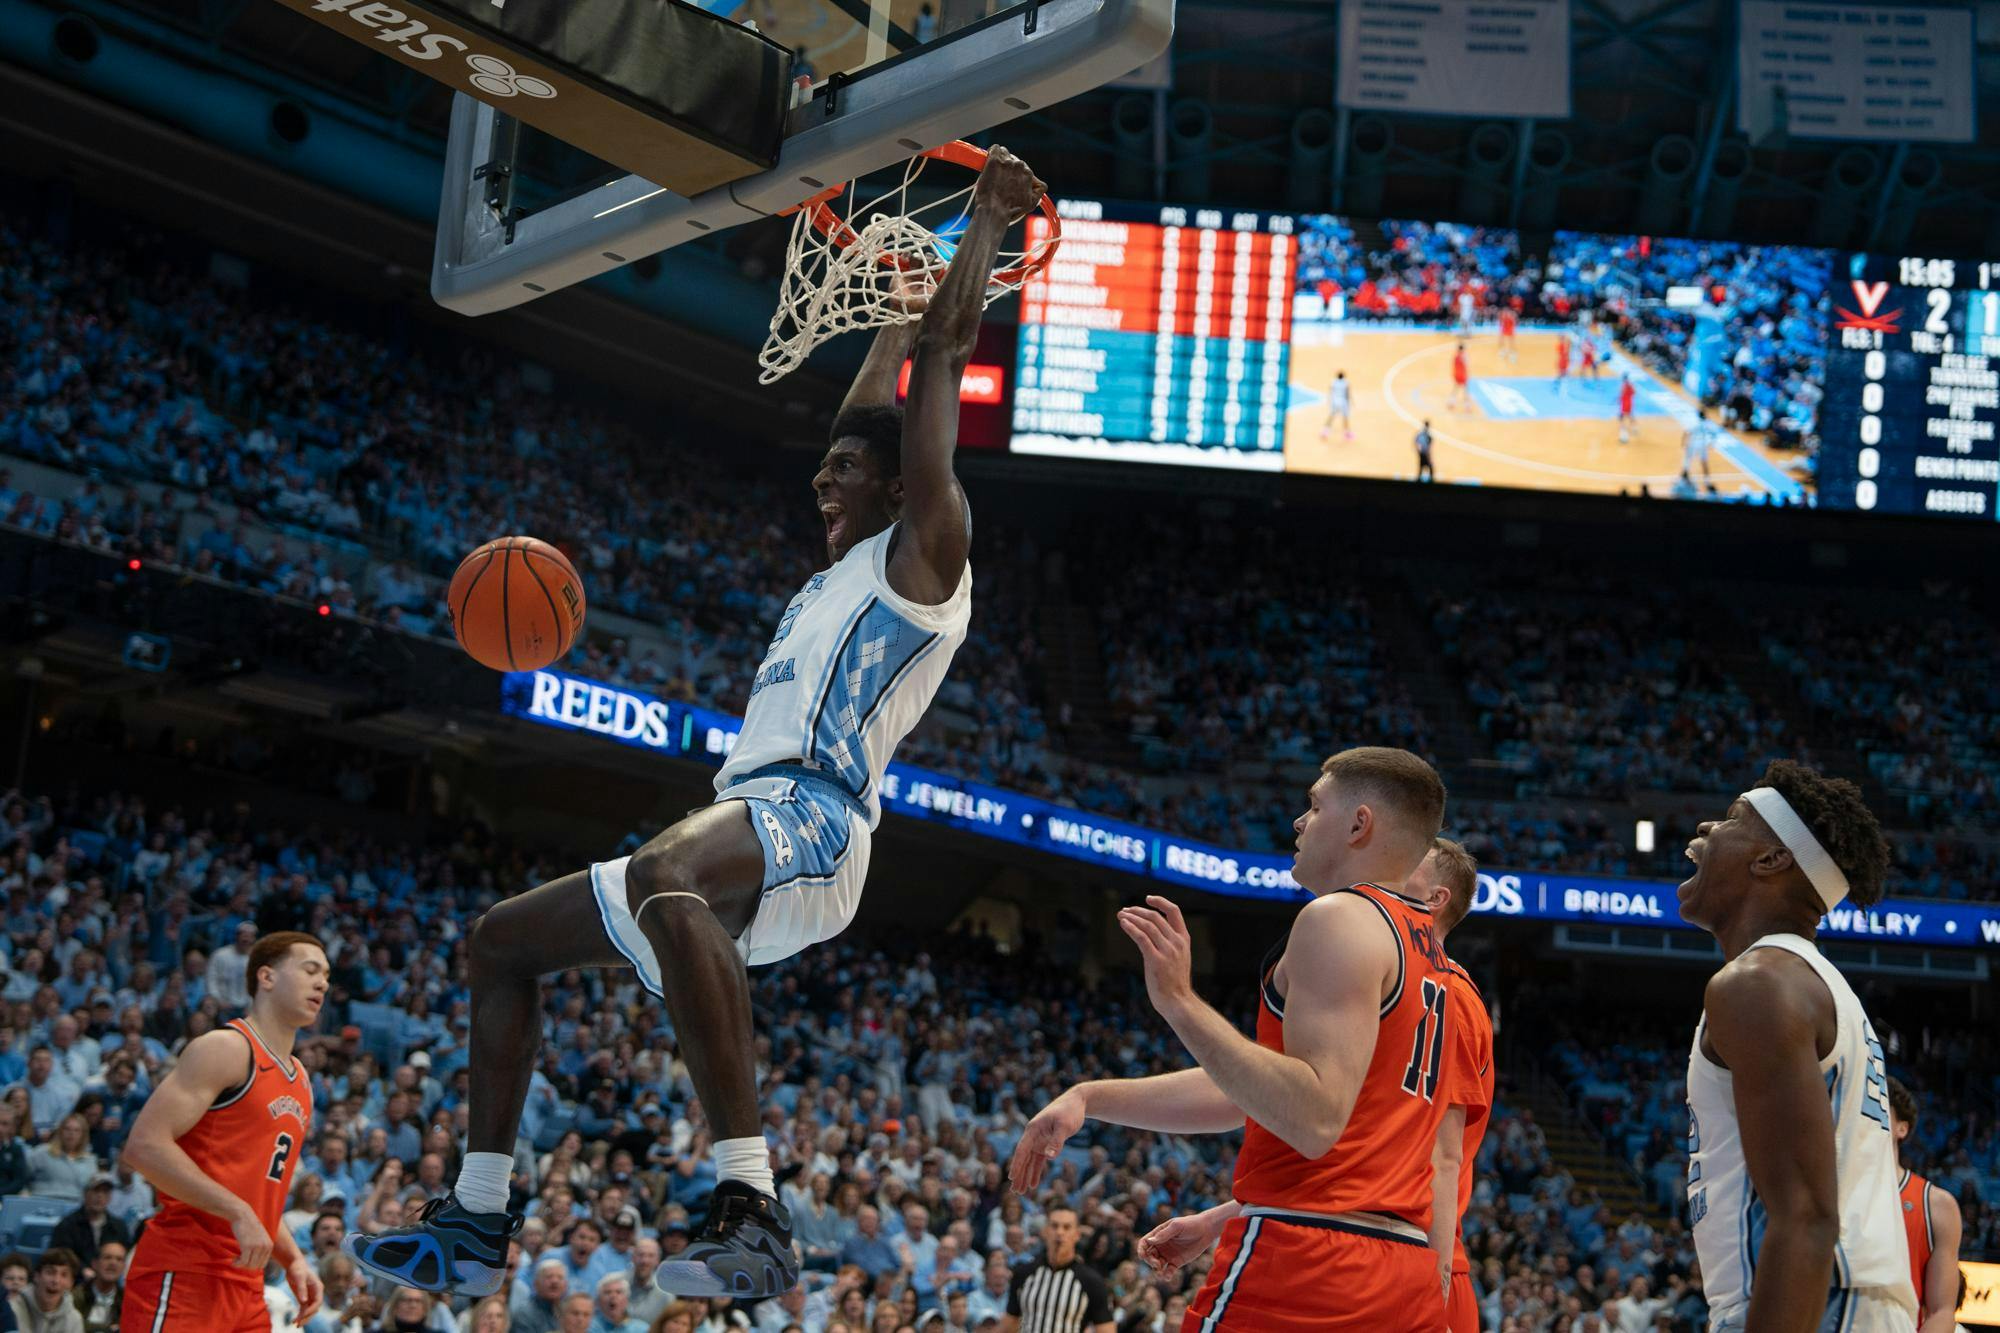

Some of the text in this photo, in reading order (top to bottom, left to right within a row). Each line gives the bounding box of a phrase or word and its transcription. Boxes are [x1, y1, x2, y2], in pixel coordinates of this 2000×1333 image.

[1899, 257, 1956, 288] 15:05
[1925, 288, 1952, 334] 2
[527, 671, 669, 748] REEDS
[904, 781, 1008, 826] JEWELRY
[1048, 816, 1146, 864] WATCHES
[1564, 888, 1664, 918] BRIDAL
[1401, 976, 1447, 1105] 11
[266, 1131, 294, 1183] 2
